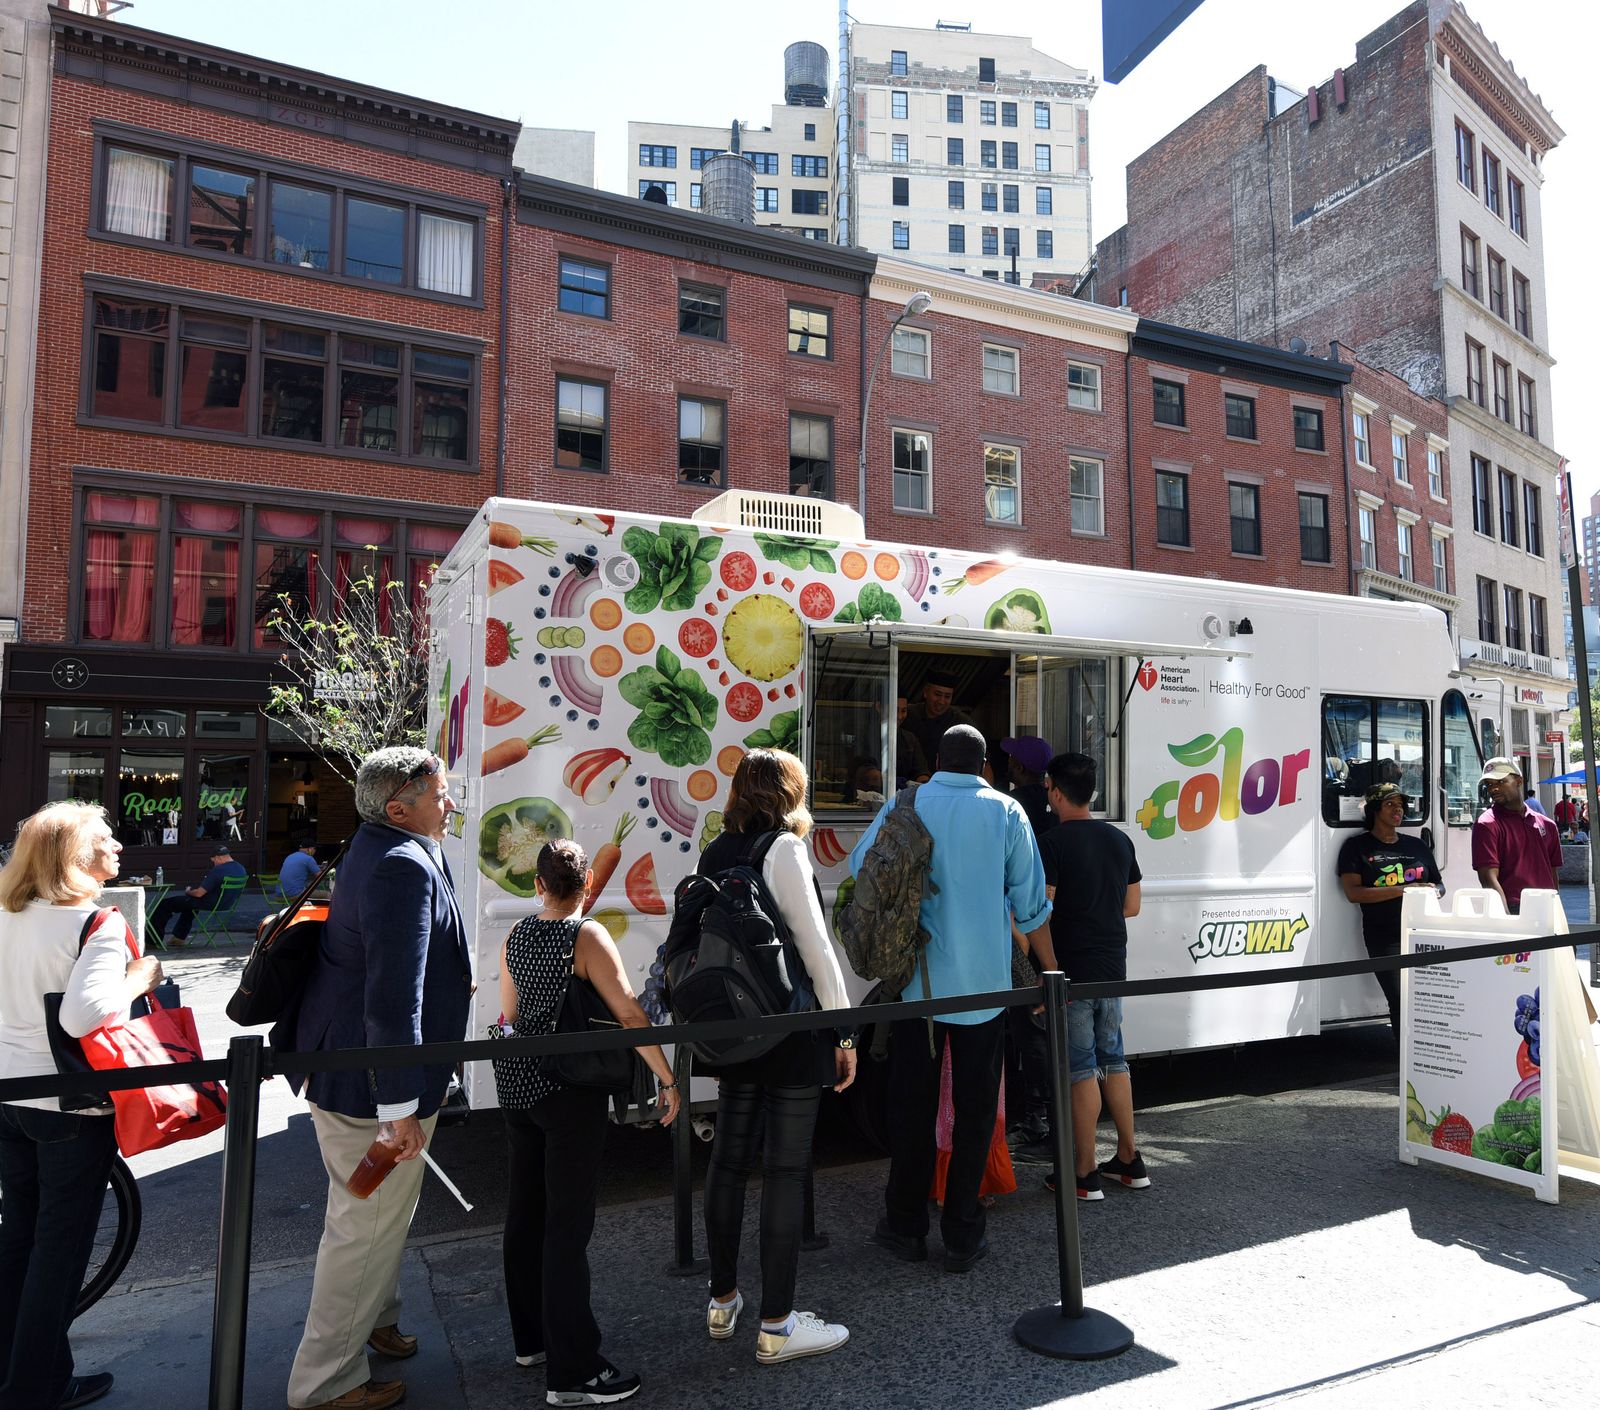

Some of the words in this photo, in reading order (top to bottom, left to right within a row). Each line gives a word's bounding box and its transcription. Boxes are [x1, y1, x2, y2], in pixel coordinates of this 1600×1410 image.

[277, 107, 325, 128] ZGE
[1161, 665, 1190, 674] American
[1161, 674, 1183, 683] Heart
[1209, 680, 1250, 698] Healthy
[1255, 683, 1272, 697] For
[1242, 908, 1277, 917] nationally
[1188, 913, 1309, 963] SUBWAY
